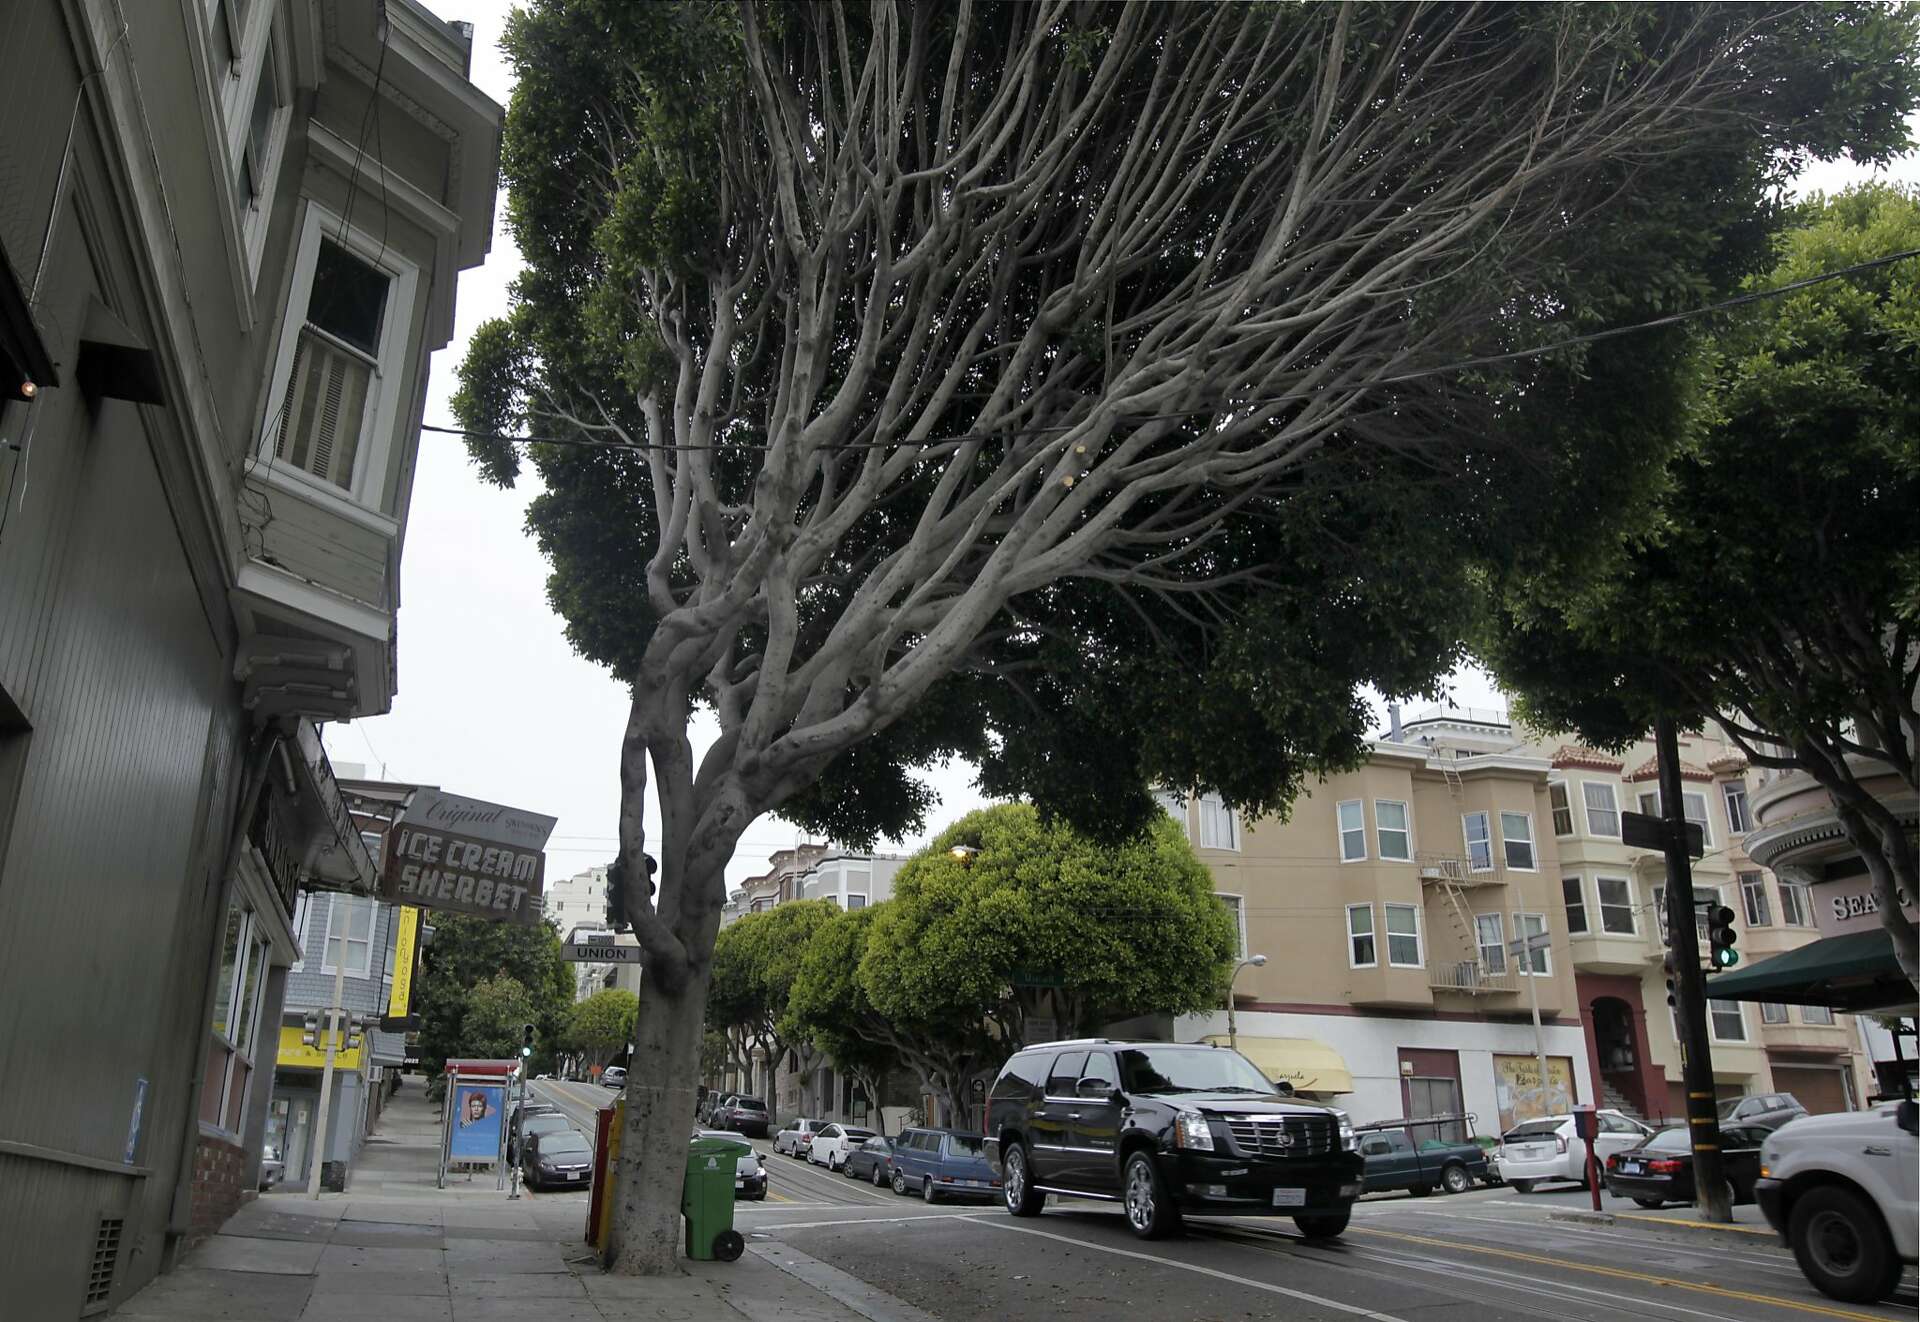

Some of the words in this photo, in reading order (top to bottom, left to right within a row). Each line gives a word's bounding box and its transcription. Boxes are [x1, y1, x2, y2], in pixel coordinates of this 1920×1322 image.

[425, 799, 503, 829] Original
[396, 829, 443, 863] ICE
[446, 840, 538, 881] CREAM
[399, 864, 528, 912] SHERBET
[577, 948, 626, 959] UNION
